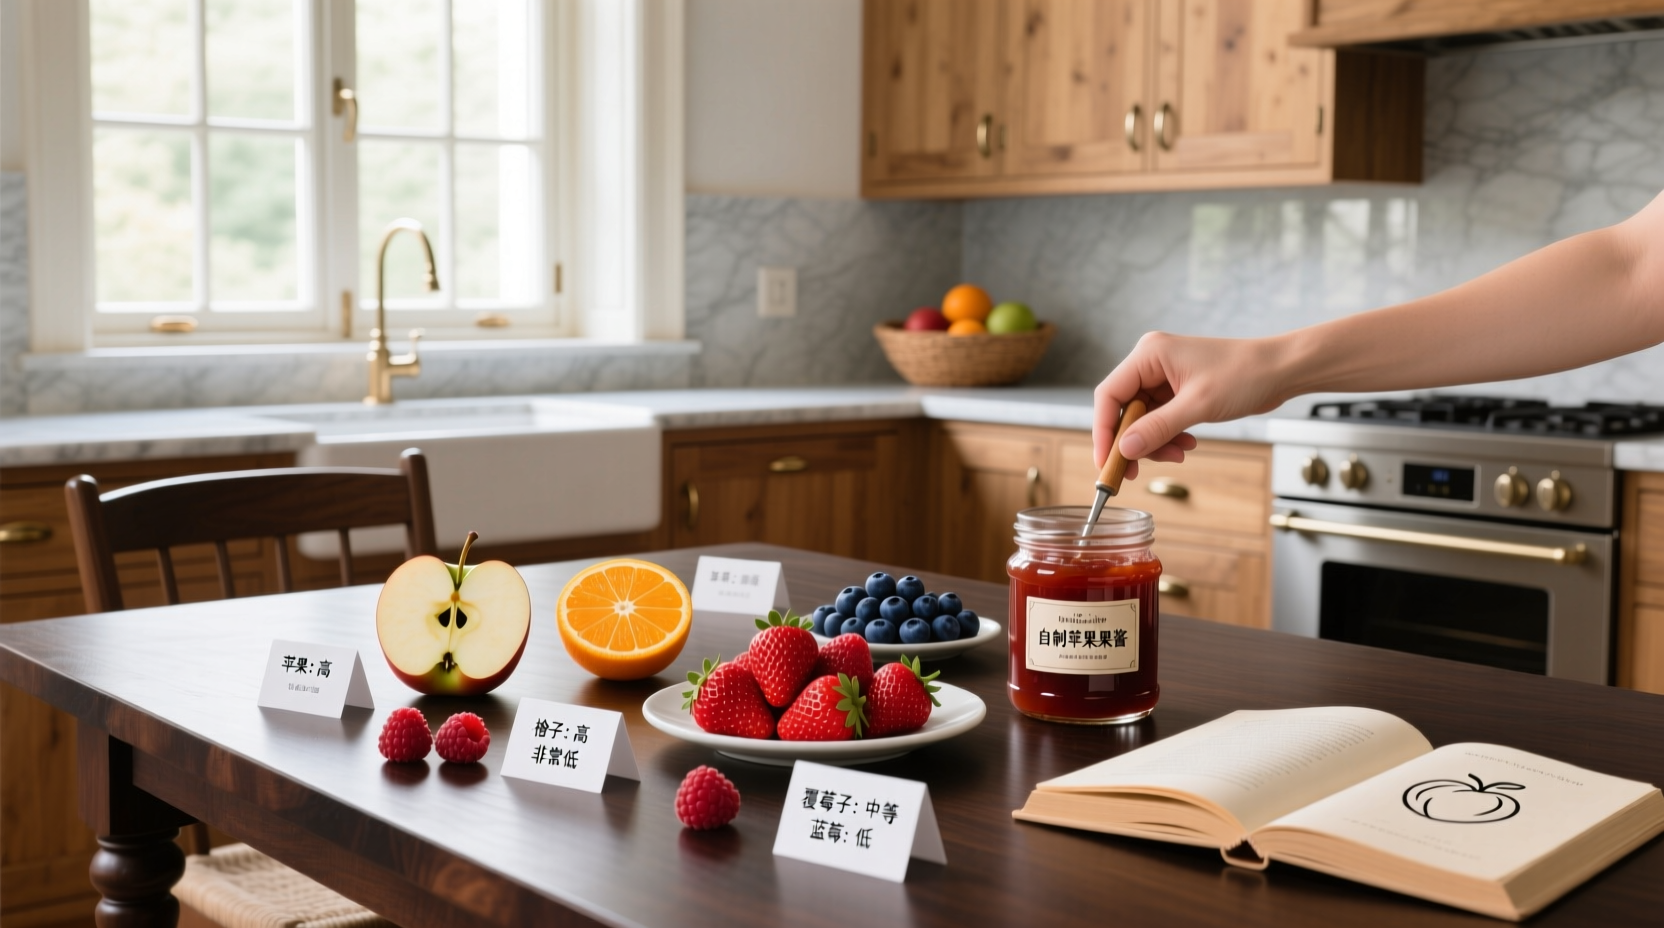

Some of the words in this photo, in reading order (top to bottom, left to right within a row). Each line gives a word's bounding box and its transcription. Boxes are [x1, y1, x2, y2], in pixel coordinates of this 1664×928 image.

[1039, 627, 1128, 649] 自制苹果果酱
